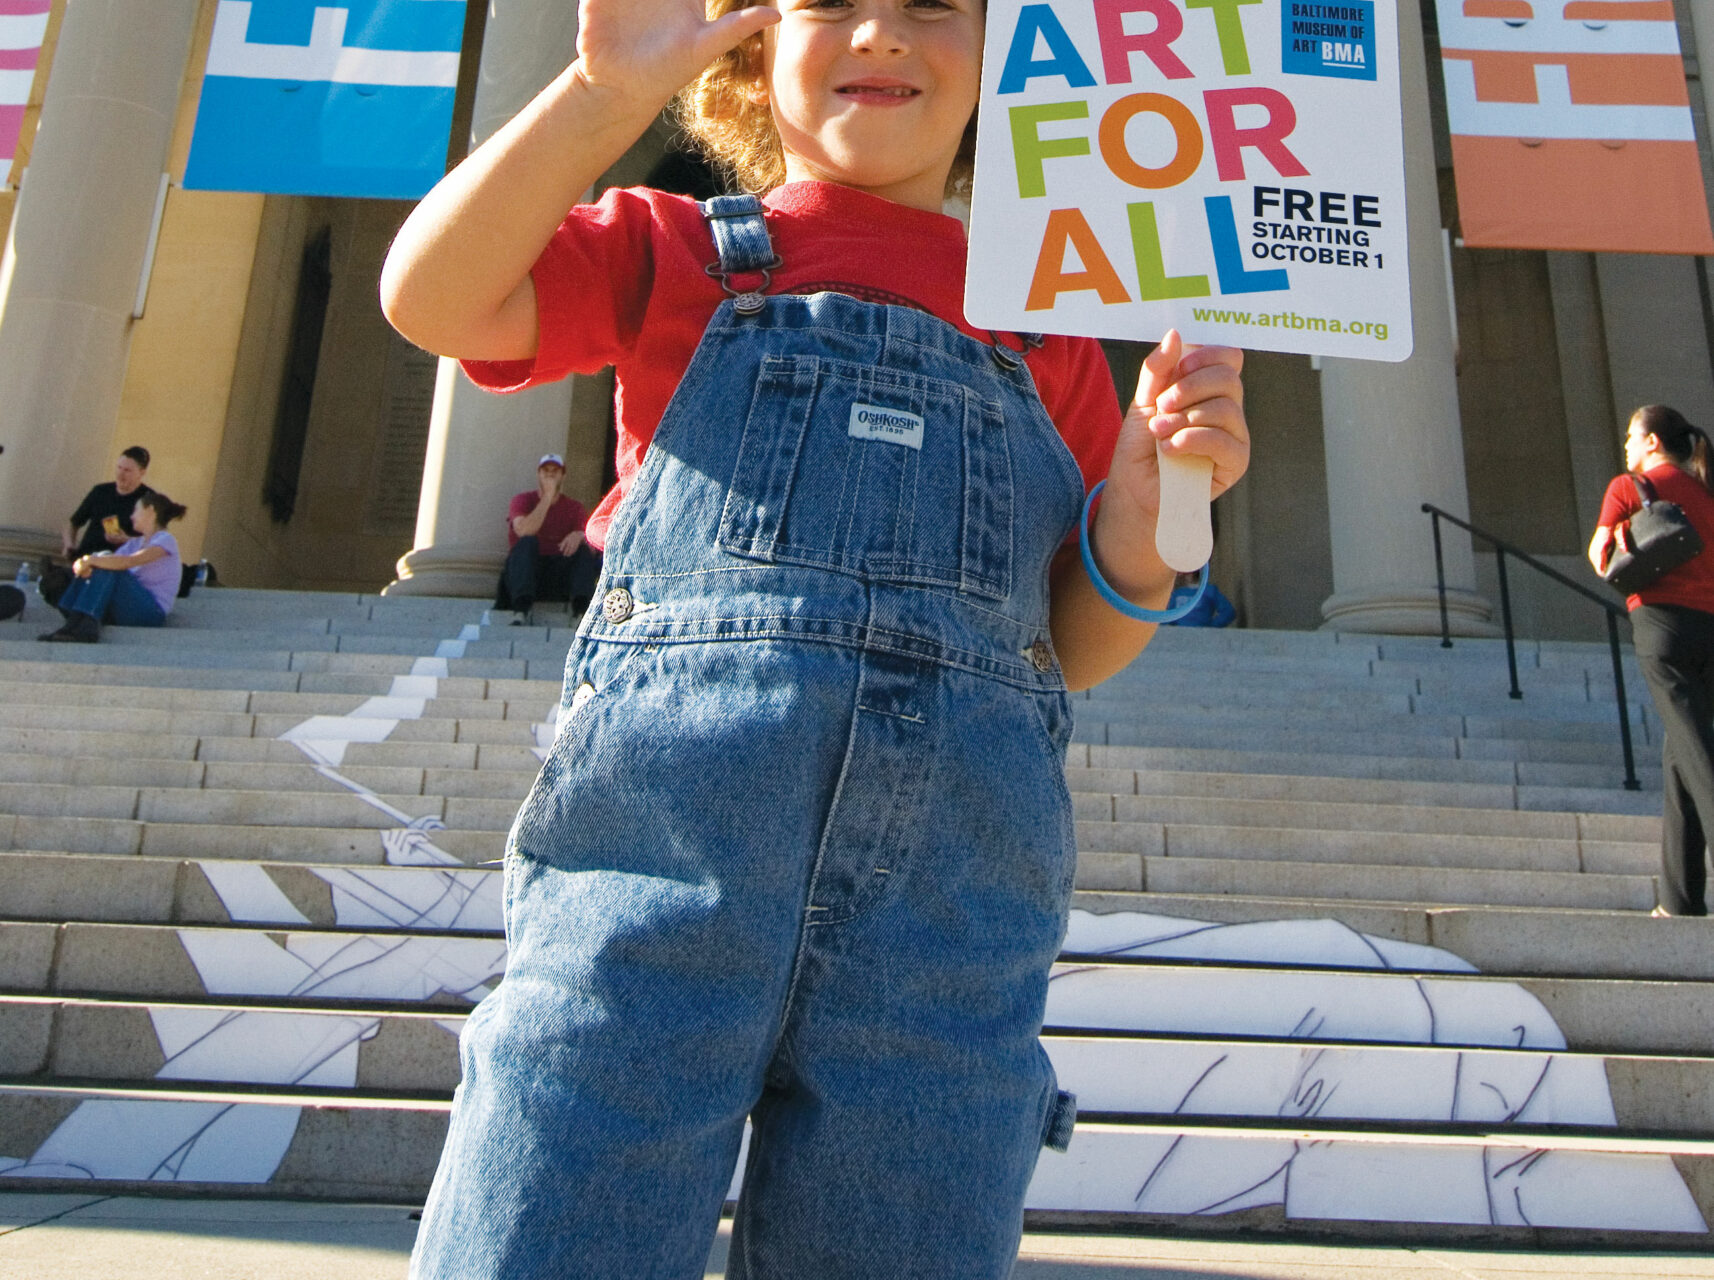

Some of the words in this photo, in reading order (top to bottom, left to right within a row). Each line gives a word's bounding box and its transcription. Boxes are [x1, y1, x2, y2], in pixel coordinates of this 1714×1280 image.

[1291, 3, 1365, 22] BALTIMORE
[1292, 21, 1347, 38] MUSEUM
[1350, 25, 1365, 39] OF
[1292, 38, 1318, 53] ART
[1321, 41, 1366, 64] BMA
[1008, 87, 1311, 199] FOR
[1253, 185, 1382, 228] FREE
[1252, 221, 1370, 248] STARTING
[1025, 195, 1291, 312] ALL
[1251, 241, 1369, 268] OCTOBER
[1373, 253, 1384, 269] 1
[1192, 308, 1389, 341] www.artbma.org
